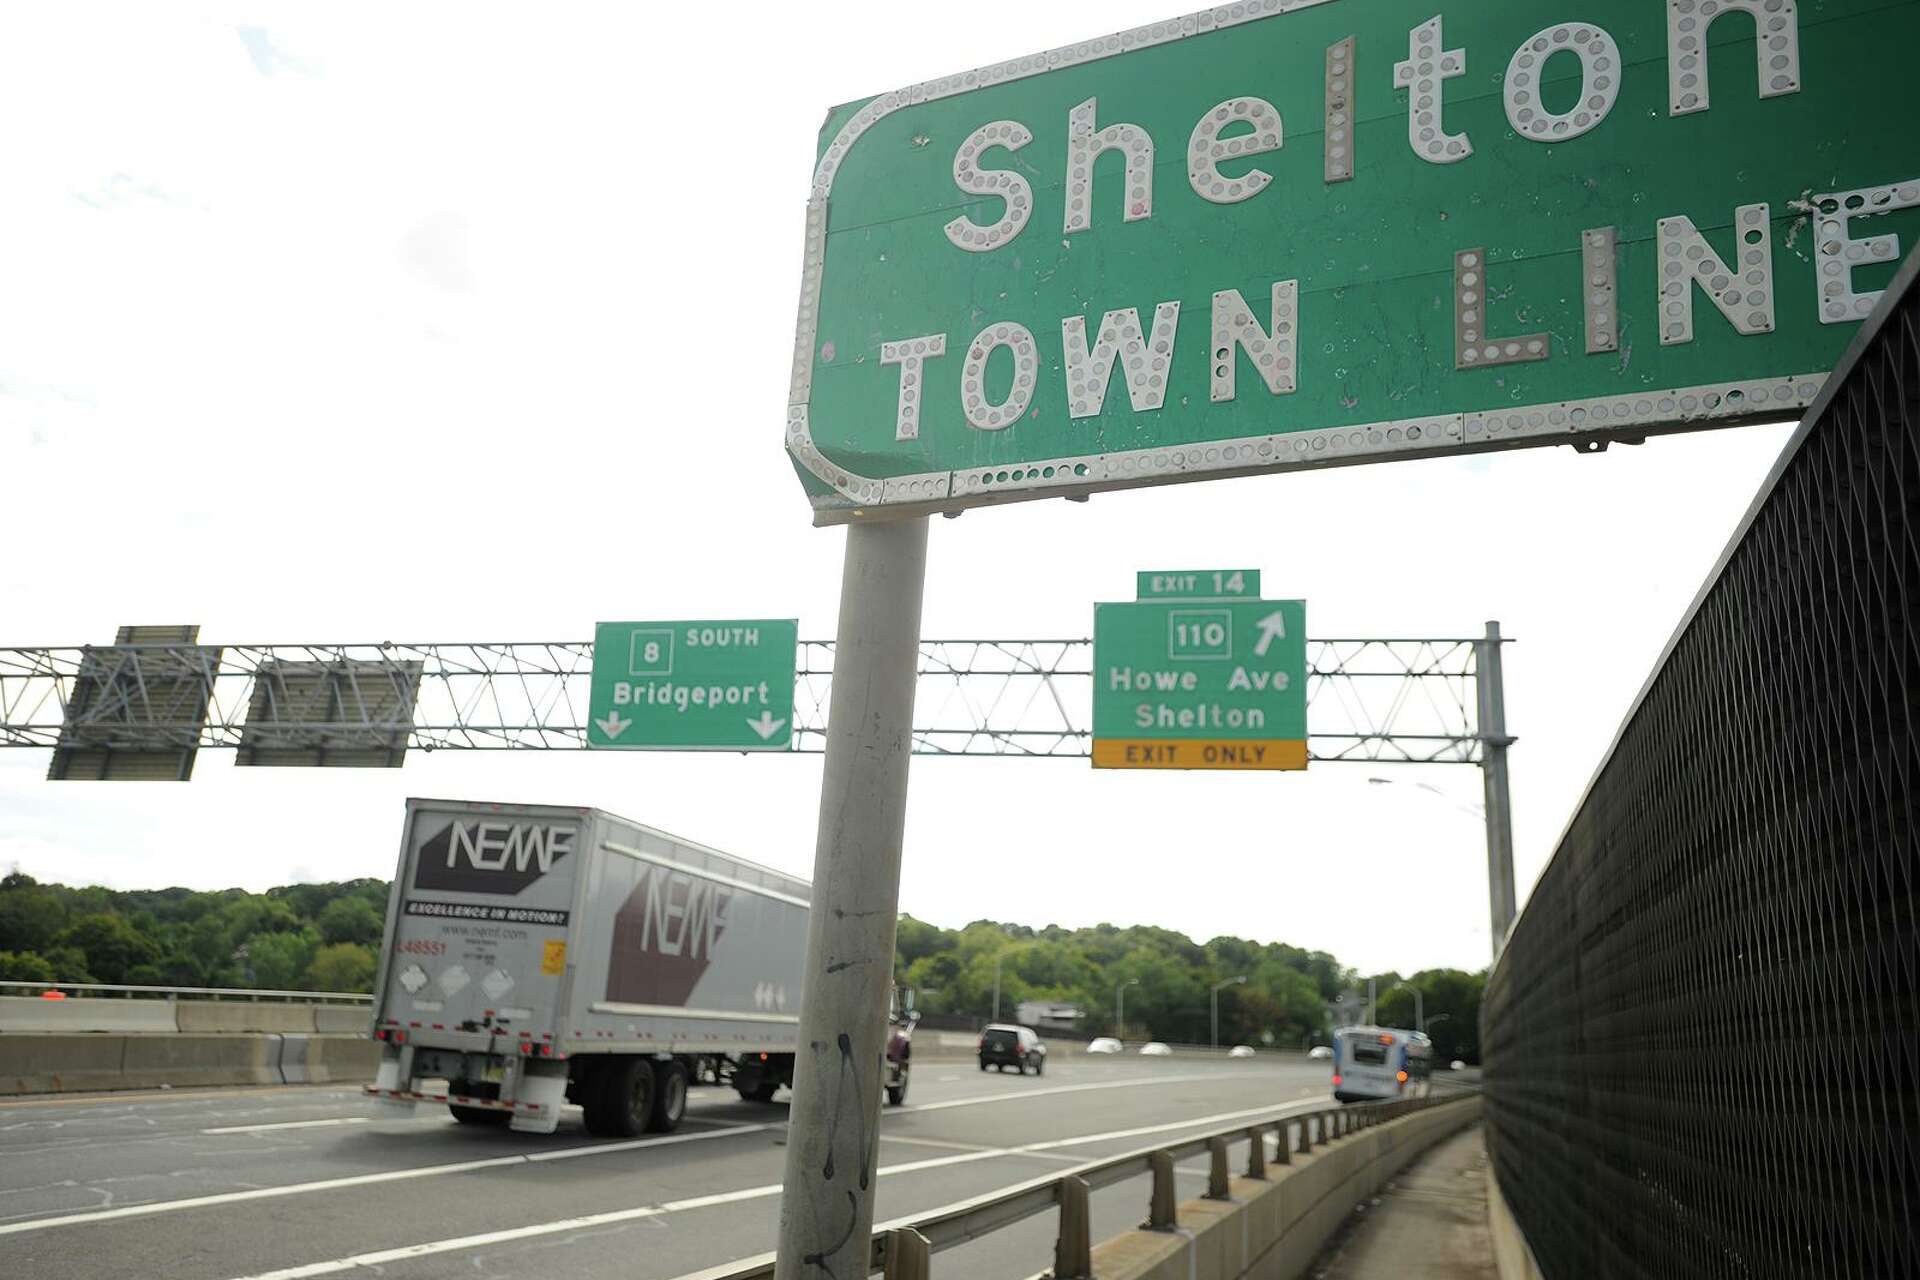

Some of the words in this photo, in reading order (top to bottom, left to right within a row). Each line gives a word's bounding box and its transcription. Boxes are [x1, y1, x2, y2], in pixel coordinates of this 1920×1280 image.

[943, 0, 1801, 252] Shelton
[880, 279, 1298, 441] TOWN
[1455, 180, 1920, 370] LINE
[1151, 575, 1197, 592] EXIT
[1213, 571, 1245, 593] 14
[644, 642, 660, 663] 8
[686, 628, 759, 646] SOUTH
[1177, 623, 1225, 646] 110
[1110, 666, 1198, 691] Howe
[1227, 666, 1290, 691] Ave
[613, 681, 769, 712] Bridgeport
[1135, 703, 1265, 728] Shelton
[1125, 745, 1178, 763] EXIT
[1202, 745, 1267, 764] ONLY
[408, 902, 490, 919] EXCELLENCE
[490, 908, 506, 920] IN
